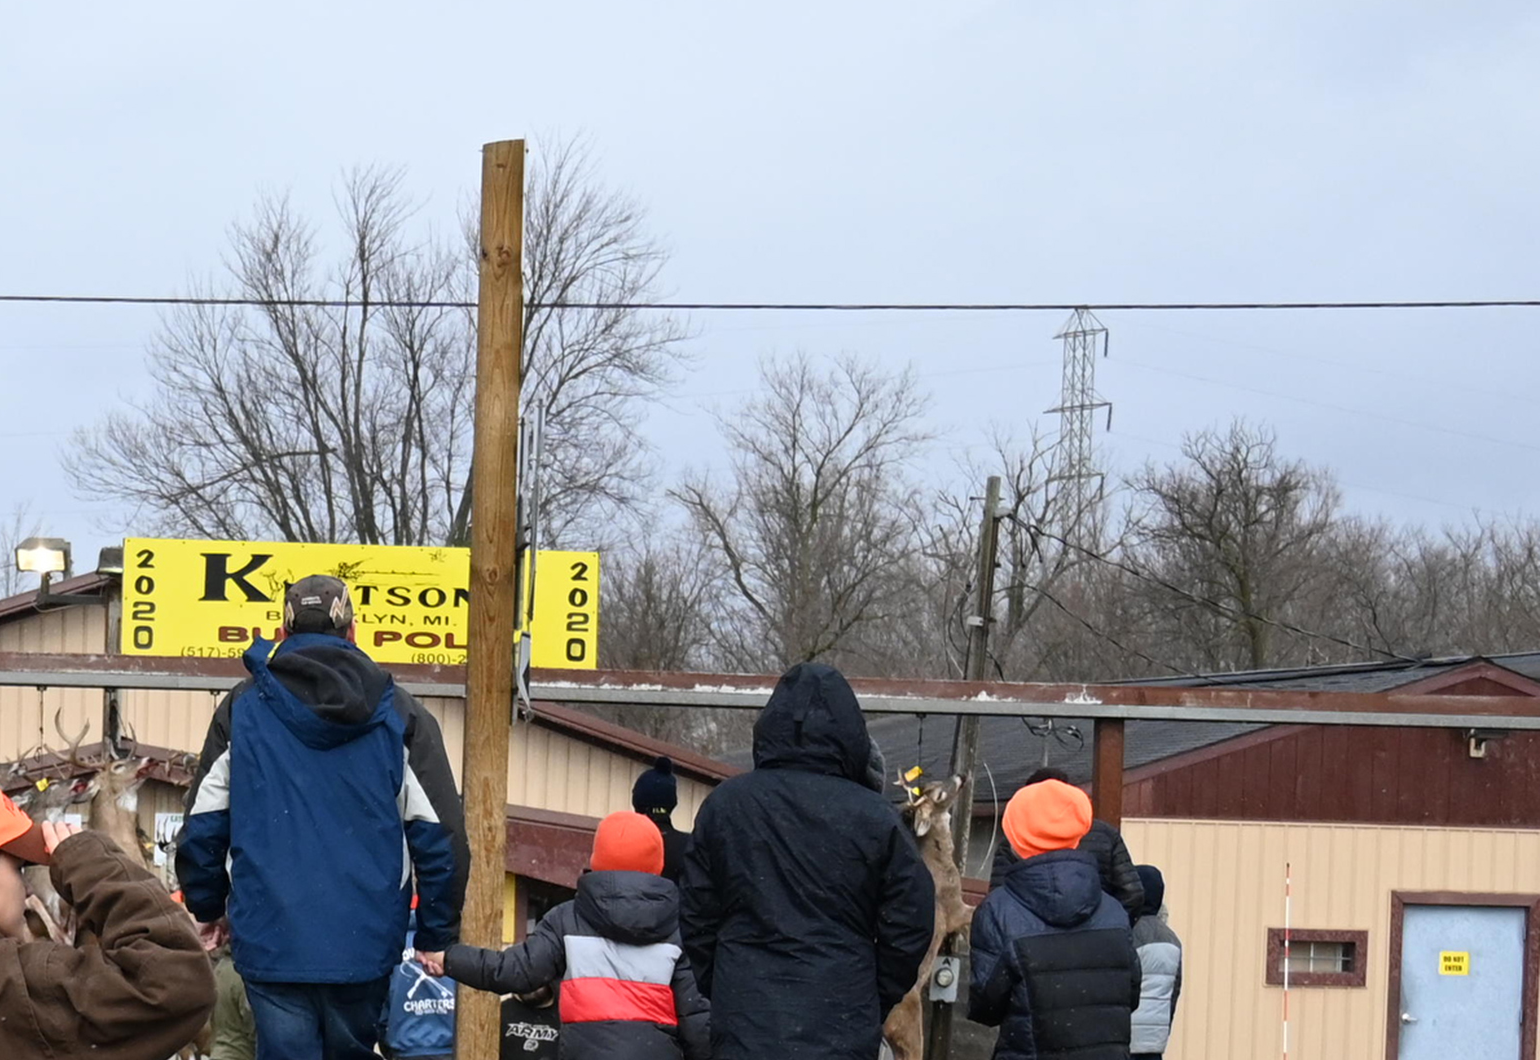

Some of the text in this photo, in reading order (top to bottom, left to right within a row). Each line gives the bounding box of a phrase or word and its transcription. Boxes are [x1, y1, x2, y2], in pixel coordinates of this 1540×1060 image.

[132, 549, 156, 649] 2020
[198, 553, 469, 607] KTSON
[424, 615, 457, 626] MI.
[566, 561, 590, 662] 2020
[181, 647, 467, 665] (517)-59 (800)-2
[219, 626, 467, 649] BU POL
